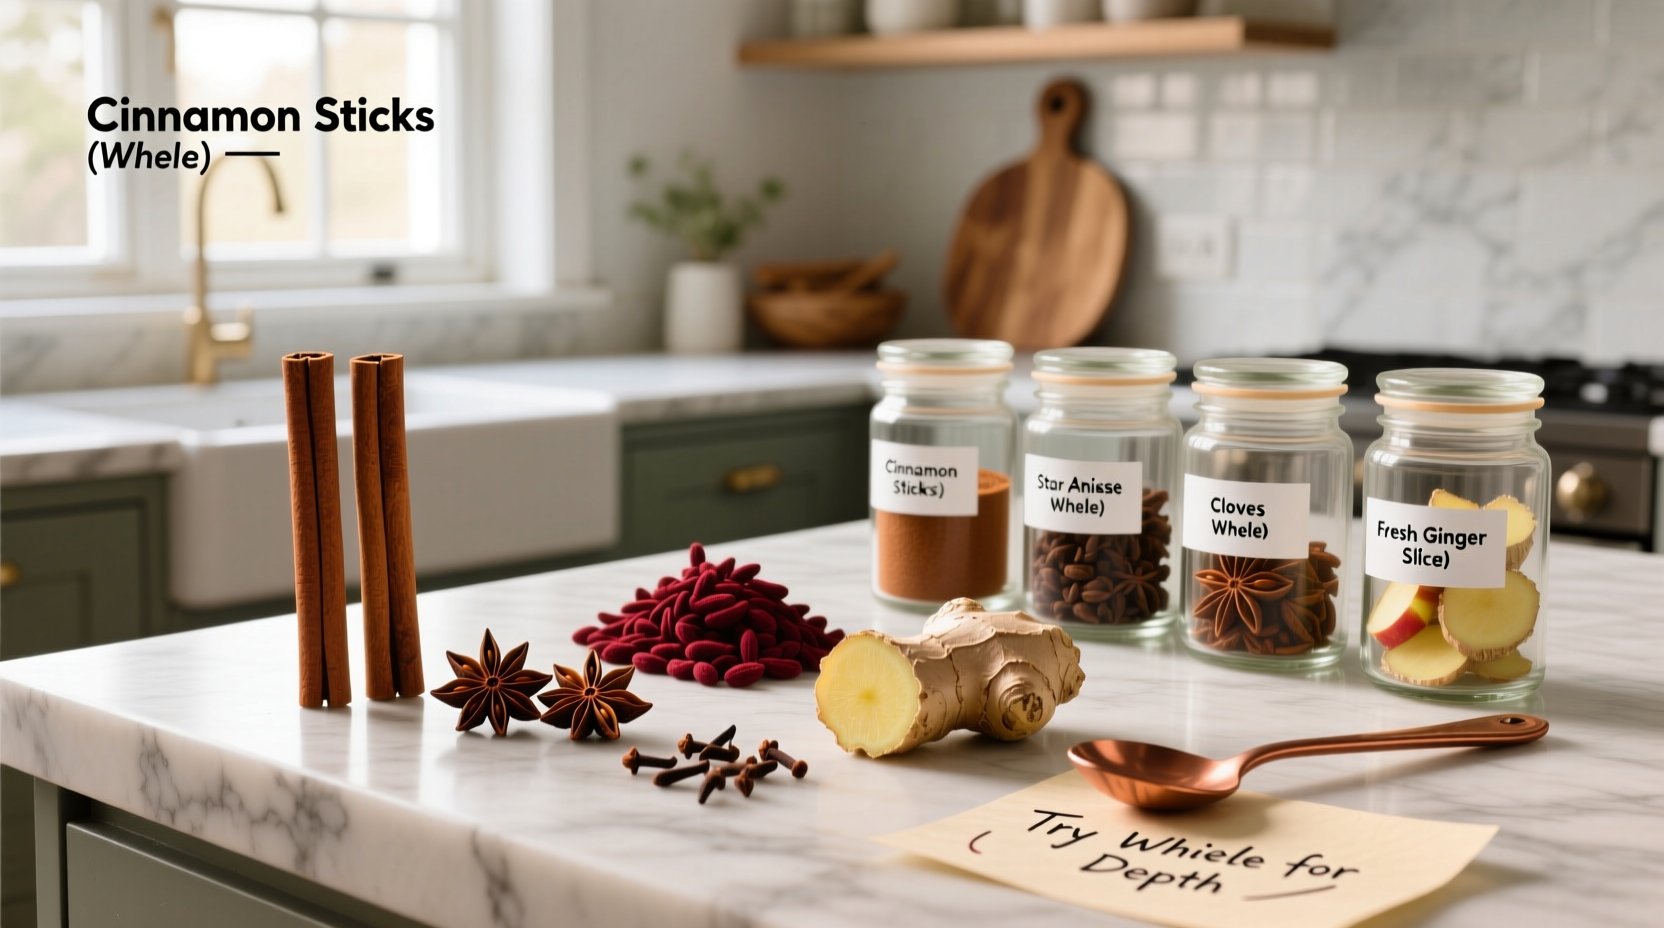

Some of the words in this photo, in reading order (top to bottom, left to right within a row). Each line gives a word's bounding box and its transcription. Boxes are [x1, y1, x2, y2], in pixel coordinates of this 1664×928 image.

[885, 459, 958, 478] Cinnamon
[1037, 474, 1064, 491] Star
[1050, 497, 1105, 517] Whele)
[1211, 497, 1266, 517] Cloves
[1211, 519, 1269, 540] Whele)
[1377, 521, 1418, 543] Fresh
[1423, 526, 1487, 550] Ginger
[1027, 809, 1098, 849] Try
[1283, 854, 1360, 880] for
[1080, 853, 1222, 893] Depth
